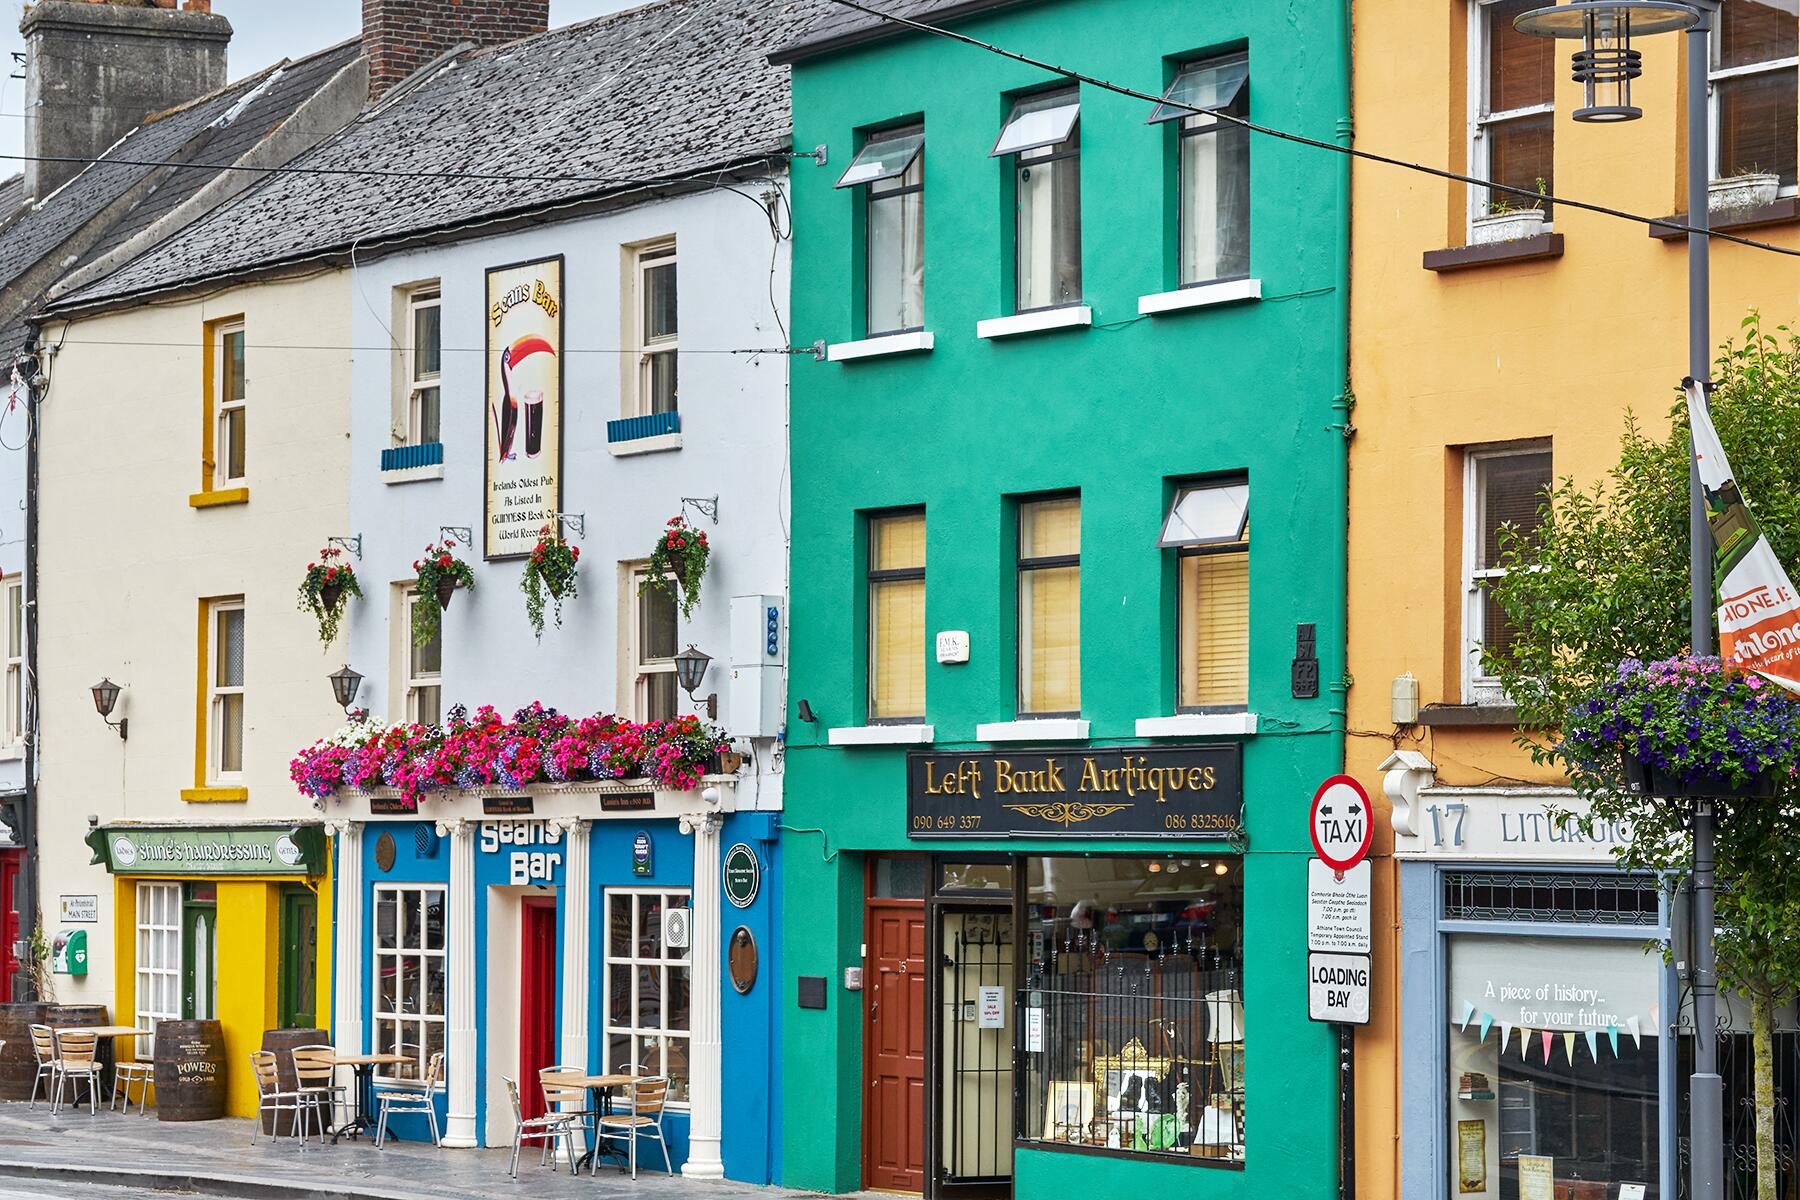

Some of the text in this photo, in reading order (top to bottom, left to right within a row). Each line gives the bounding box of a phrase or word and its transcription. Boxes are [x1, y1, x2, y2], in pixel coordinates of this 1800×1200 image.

[491, 278, 558, 328] Seans Bar
[493, 475, 554, 491] Irelands Oldest Pub
[504, 493, 542, 507] As Listed In
[491, 511, 527, 525] GUINNESS
[528, 510, 545, 521] Book
[499, 529, 519, 540] World
[1764, 652, 1784, 668] heart
[1785, 648, 1793, 661] of
[925, 755, 1217, 802] Left Bank Antiques
[913, 815, 982, 829] 090 649 3377
[1165, 814, 1236, 829] 086 8325616
[1320, 819, 1362, 843] TAXI
[1425, 803, 1468, 847] 17
[481, 820, 561, 853] Seans
[510, 851, 561, 886] Bar
[68, 910, 96, 918] MAIN STREET
[1312, 966, 1367, 987] LOADING
[1327, 990, 1350, 1008] BAY
[1484, 980, 1496, 998] A
[1500, 982, 1532, 1002] piece
[1535, 983, 1550, 1001] of
[1520, 1006, 1538, 1024] for
[1543, 1011, 1572, 1027] your
[177, 1062, 216, 1074] POWERS
